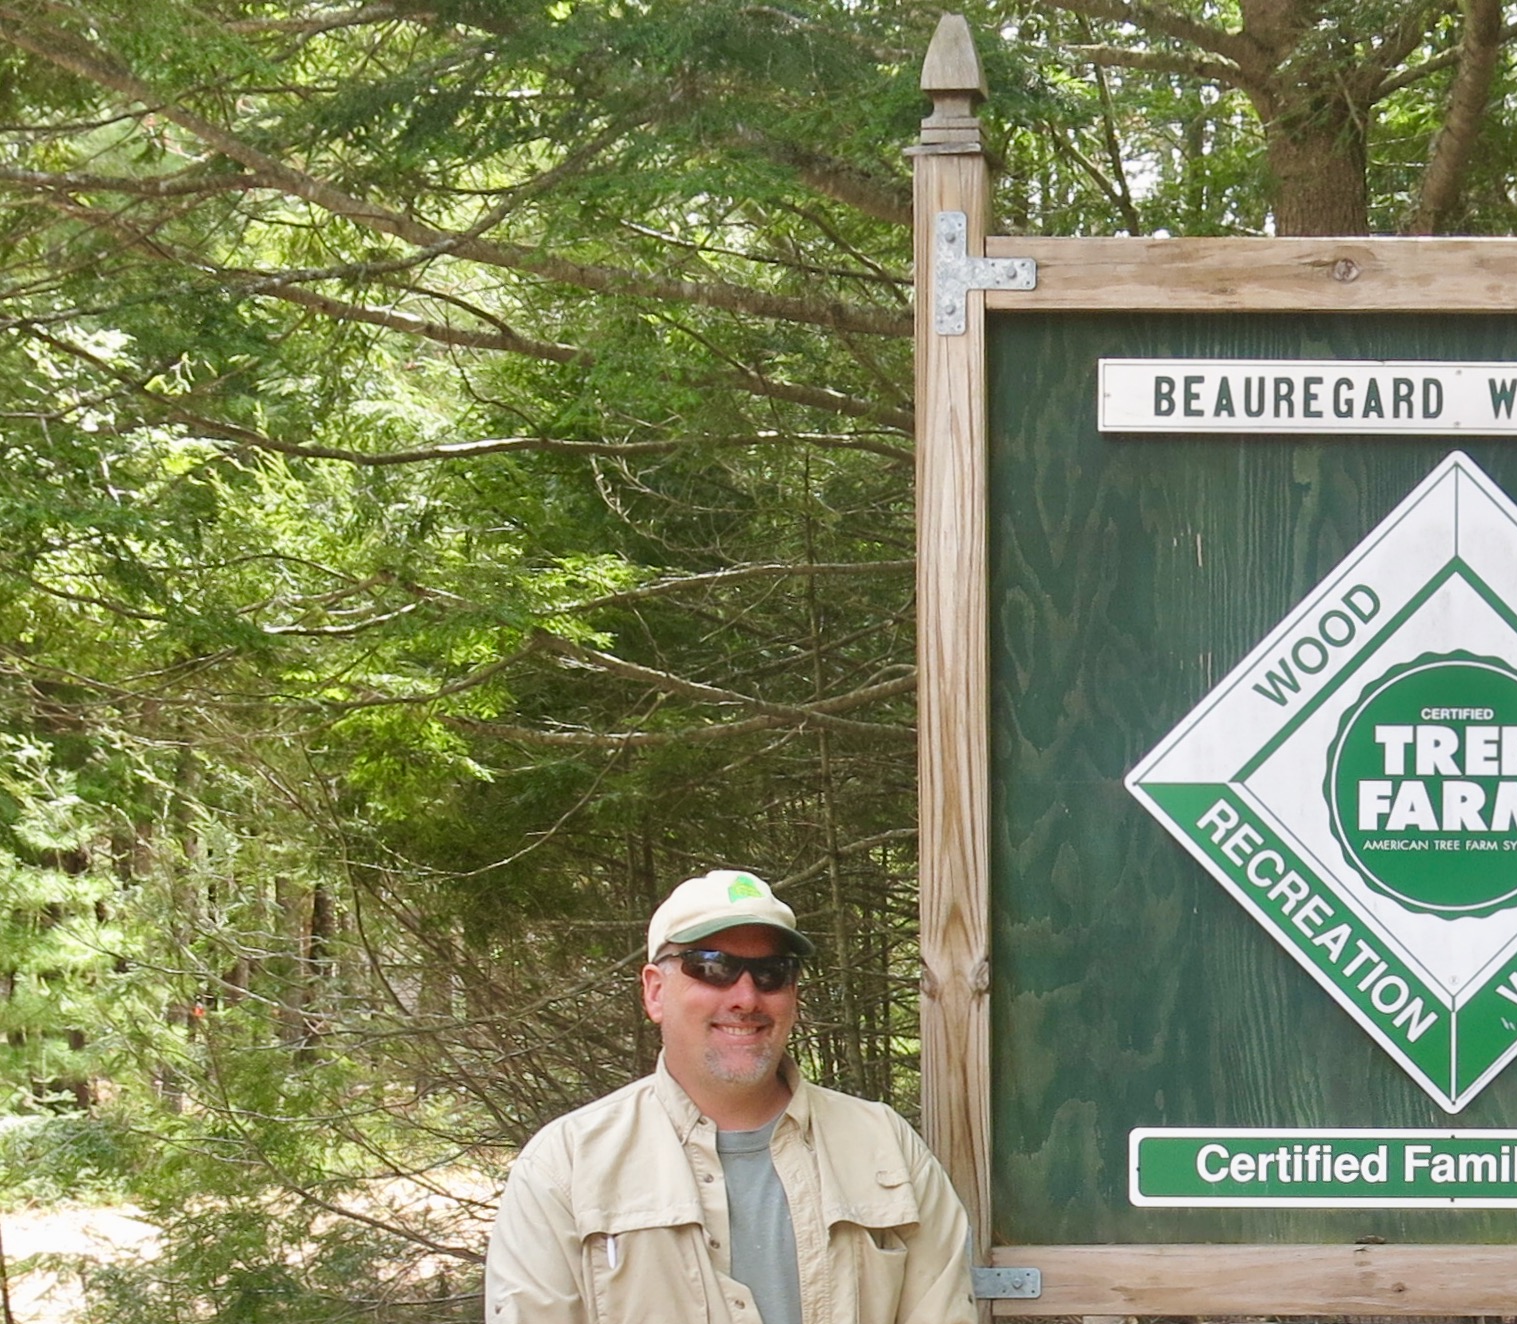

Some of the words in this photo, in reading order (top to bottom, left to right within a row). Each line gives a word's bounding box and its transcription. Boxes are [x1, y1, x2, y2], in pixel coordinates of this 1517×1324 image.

[1154, 375, 1444, 420] BEAUREGARD
[1252, 583, 1381, 710] WOOD
[1420, 707, 1495, 721] CERTIFIED
[1362, 839, 1430, 851] AMERICAN
[1434, 840, 1461, 851] TREE
[1465, 840, 1499, 852] FARM
[1195, 798, 1438, 1043] RECREATION
[1195, 1143, 1388, 1185] Certified
